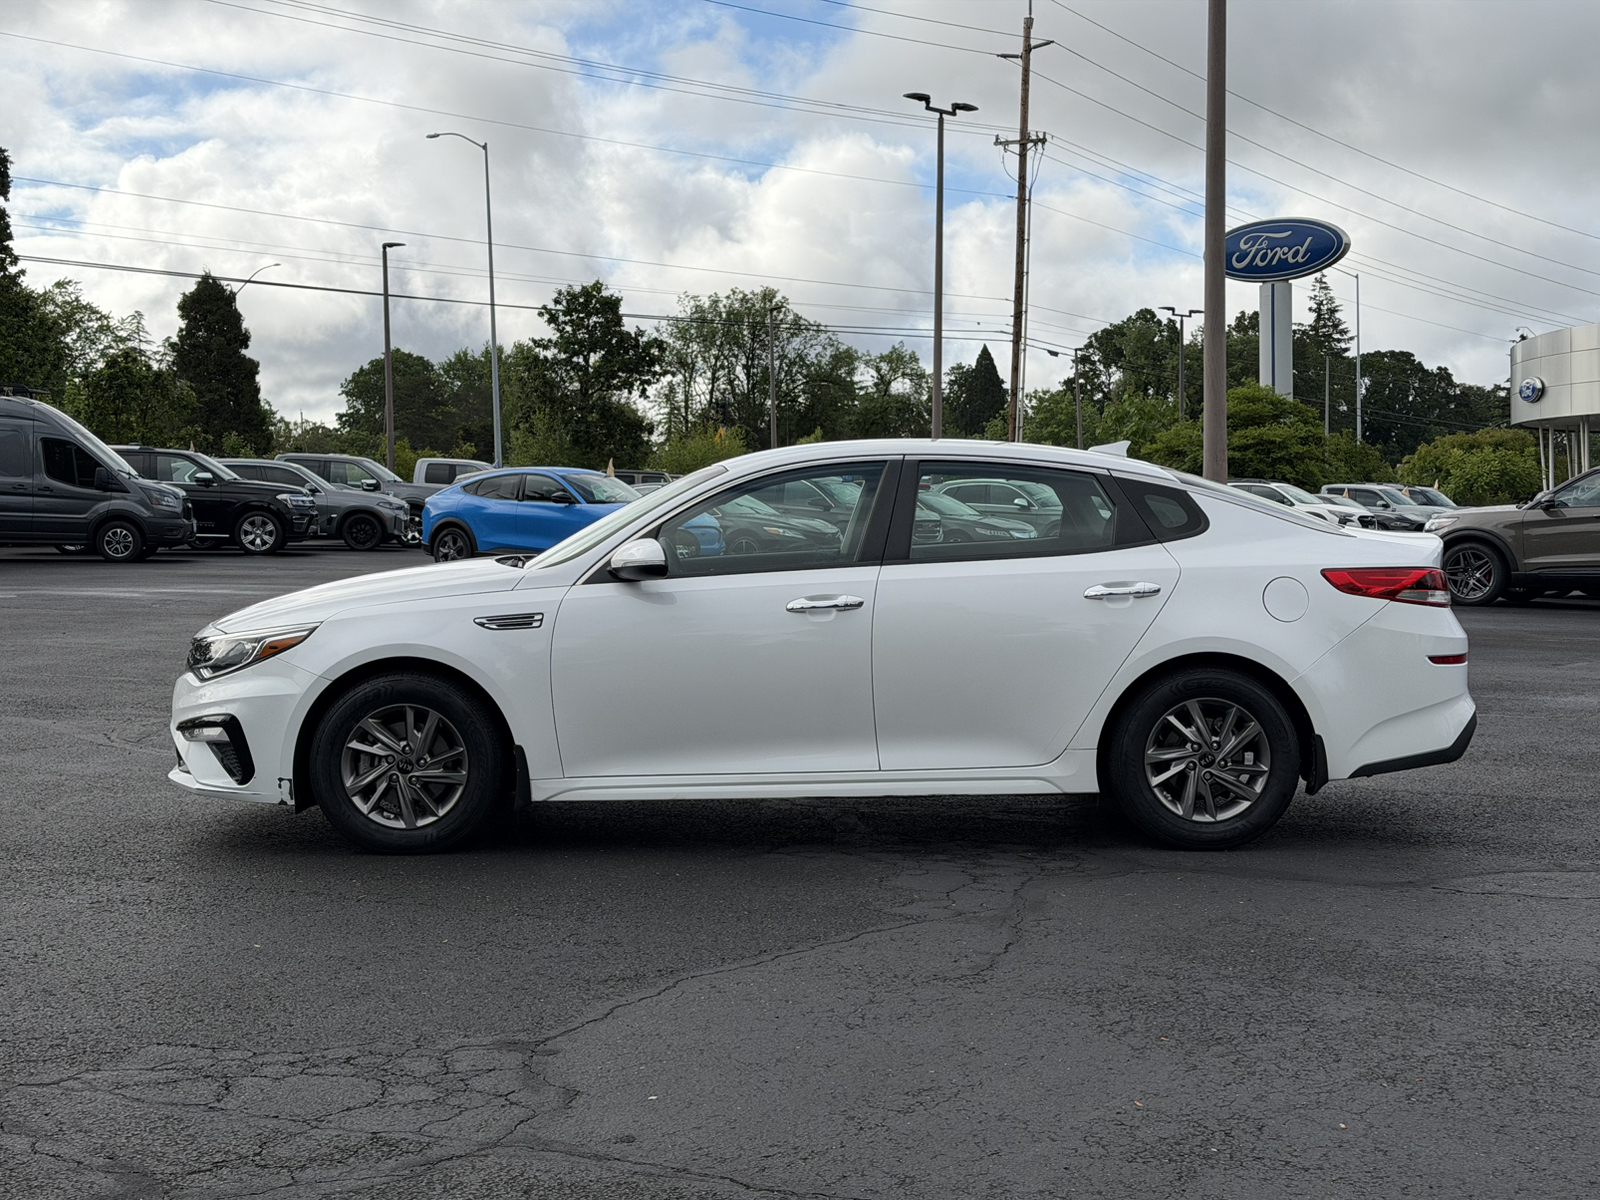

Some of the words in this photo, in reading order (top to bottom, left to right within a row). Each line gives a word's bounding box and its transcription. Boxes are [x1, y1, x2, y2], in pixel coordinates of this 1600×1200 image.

[1232, 231, 1314, 269] Ford
[1200, 755, 1215, 766] KIA
[398, 761, 413, 772] KIA
